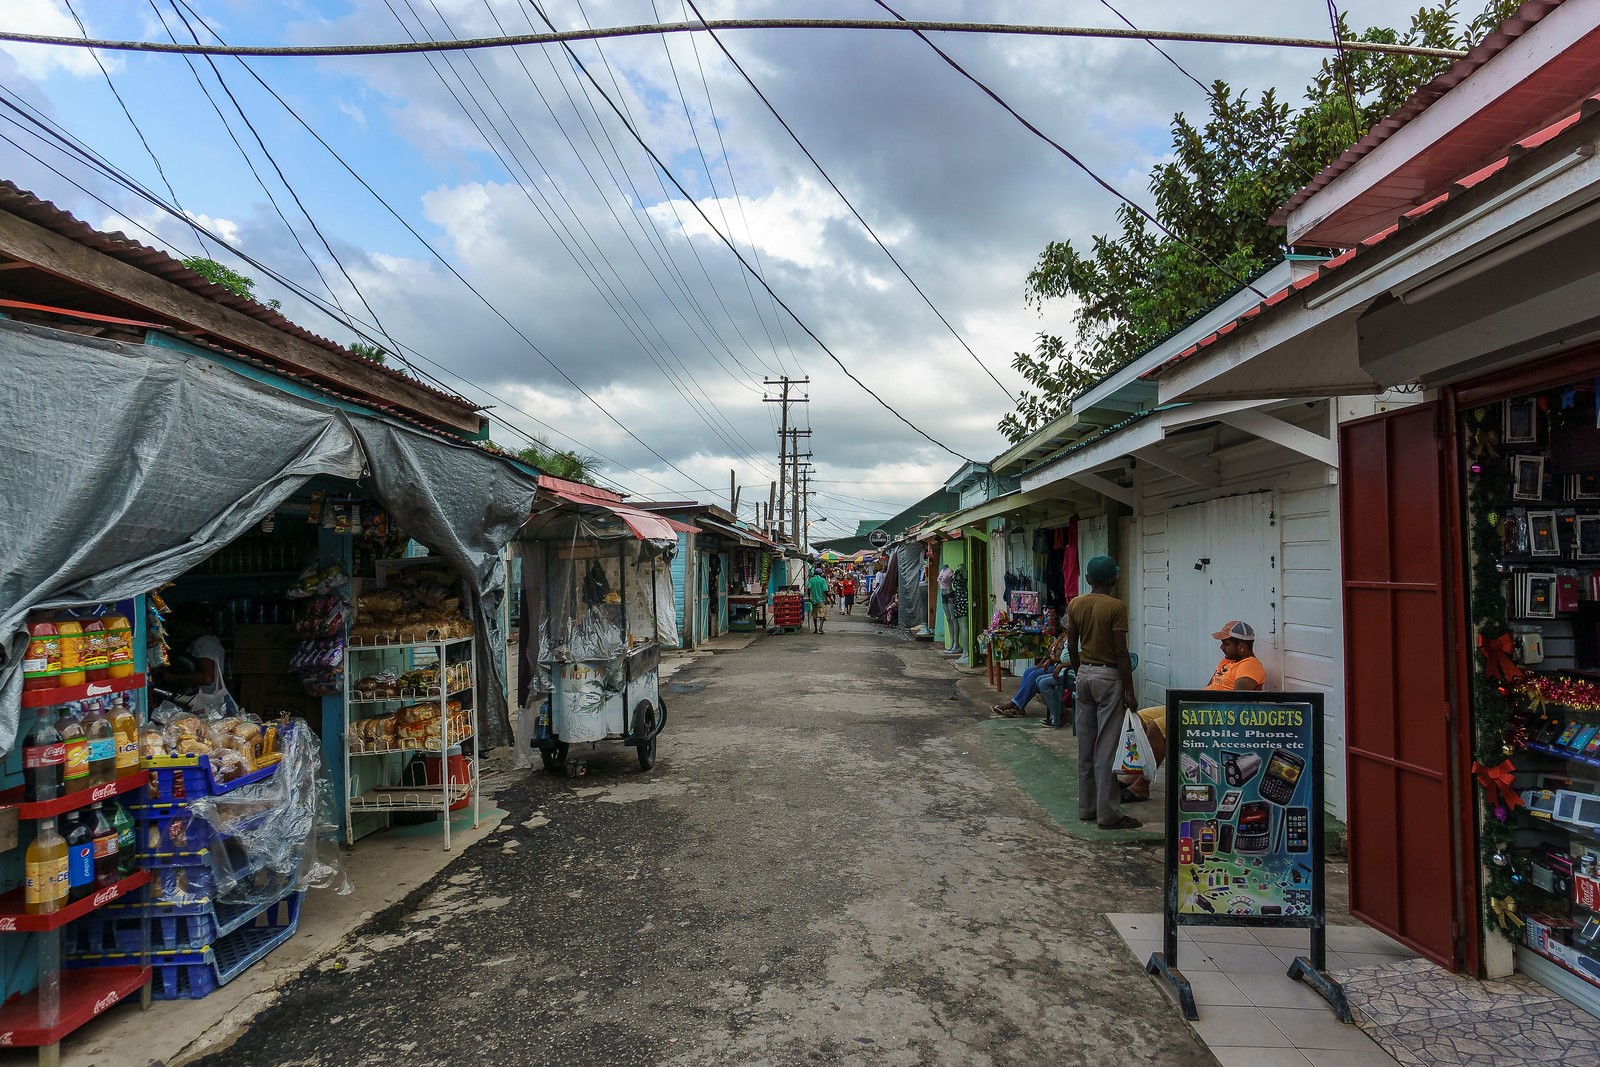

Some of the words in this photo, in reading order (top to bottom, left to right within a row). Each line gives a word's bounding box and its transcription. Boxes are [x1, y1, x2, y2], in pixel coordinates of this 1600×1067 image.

[263, 705, 305, 717] EGGS
[1181, 709, 1236, 726] SATYA'S
[1239, 710, 1303, 726] GADGETS
[1186, 729, 1240, 738] Mobile
[1245, 730, 1298, 739] Phone,
[1211, 740, 1282, 749] Accessories
